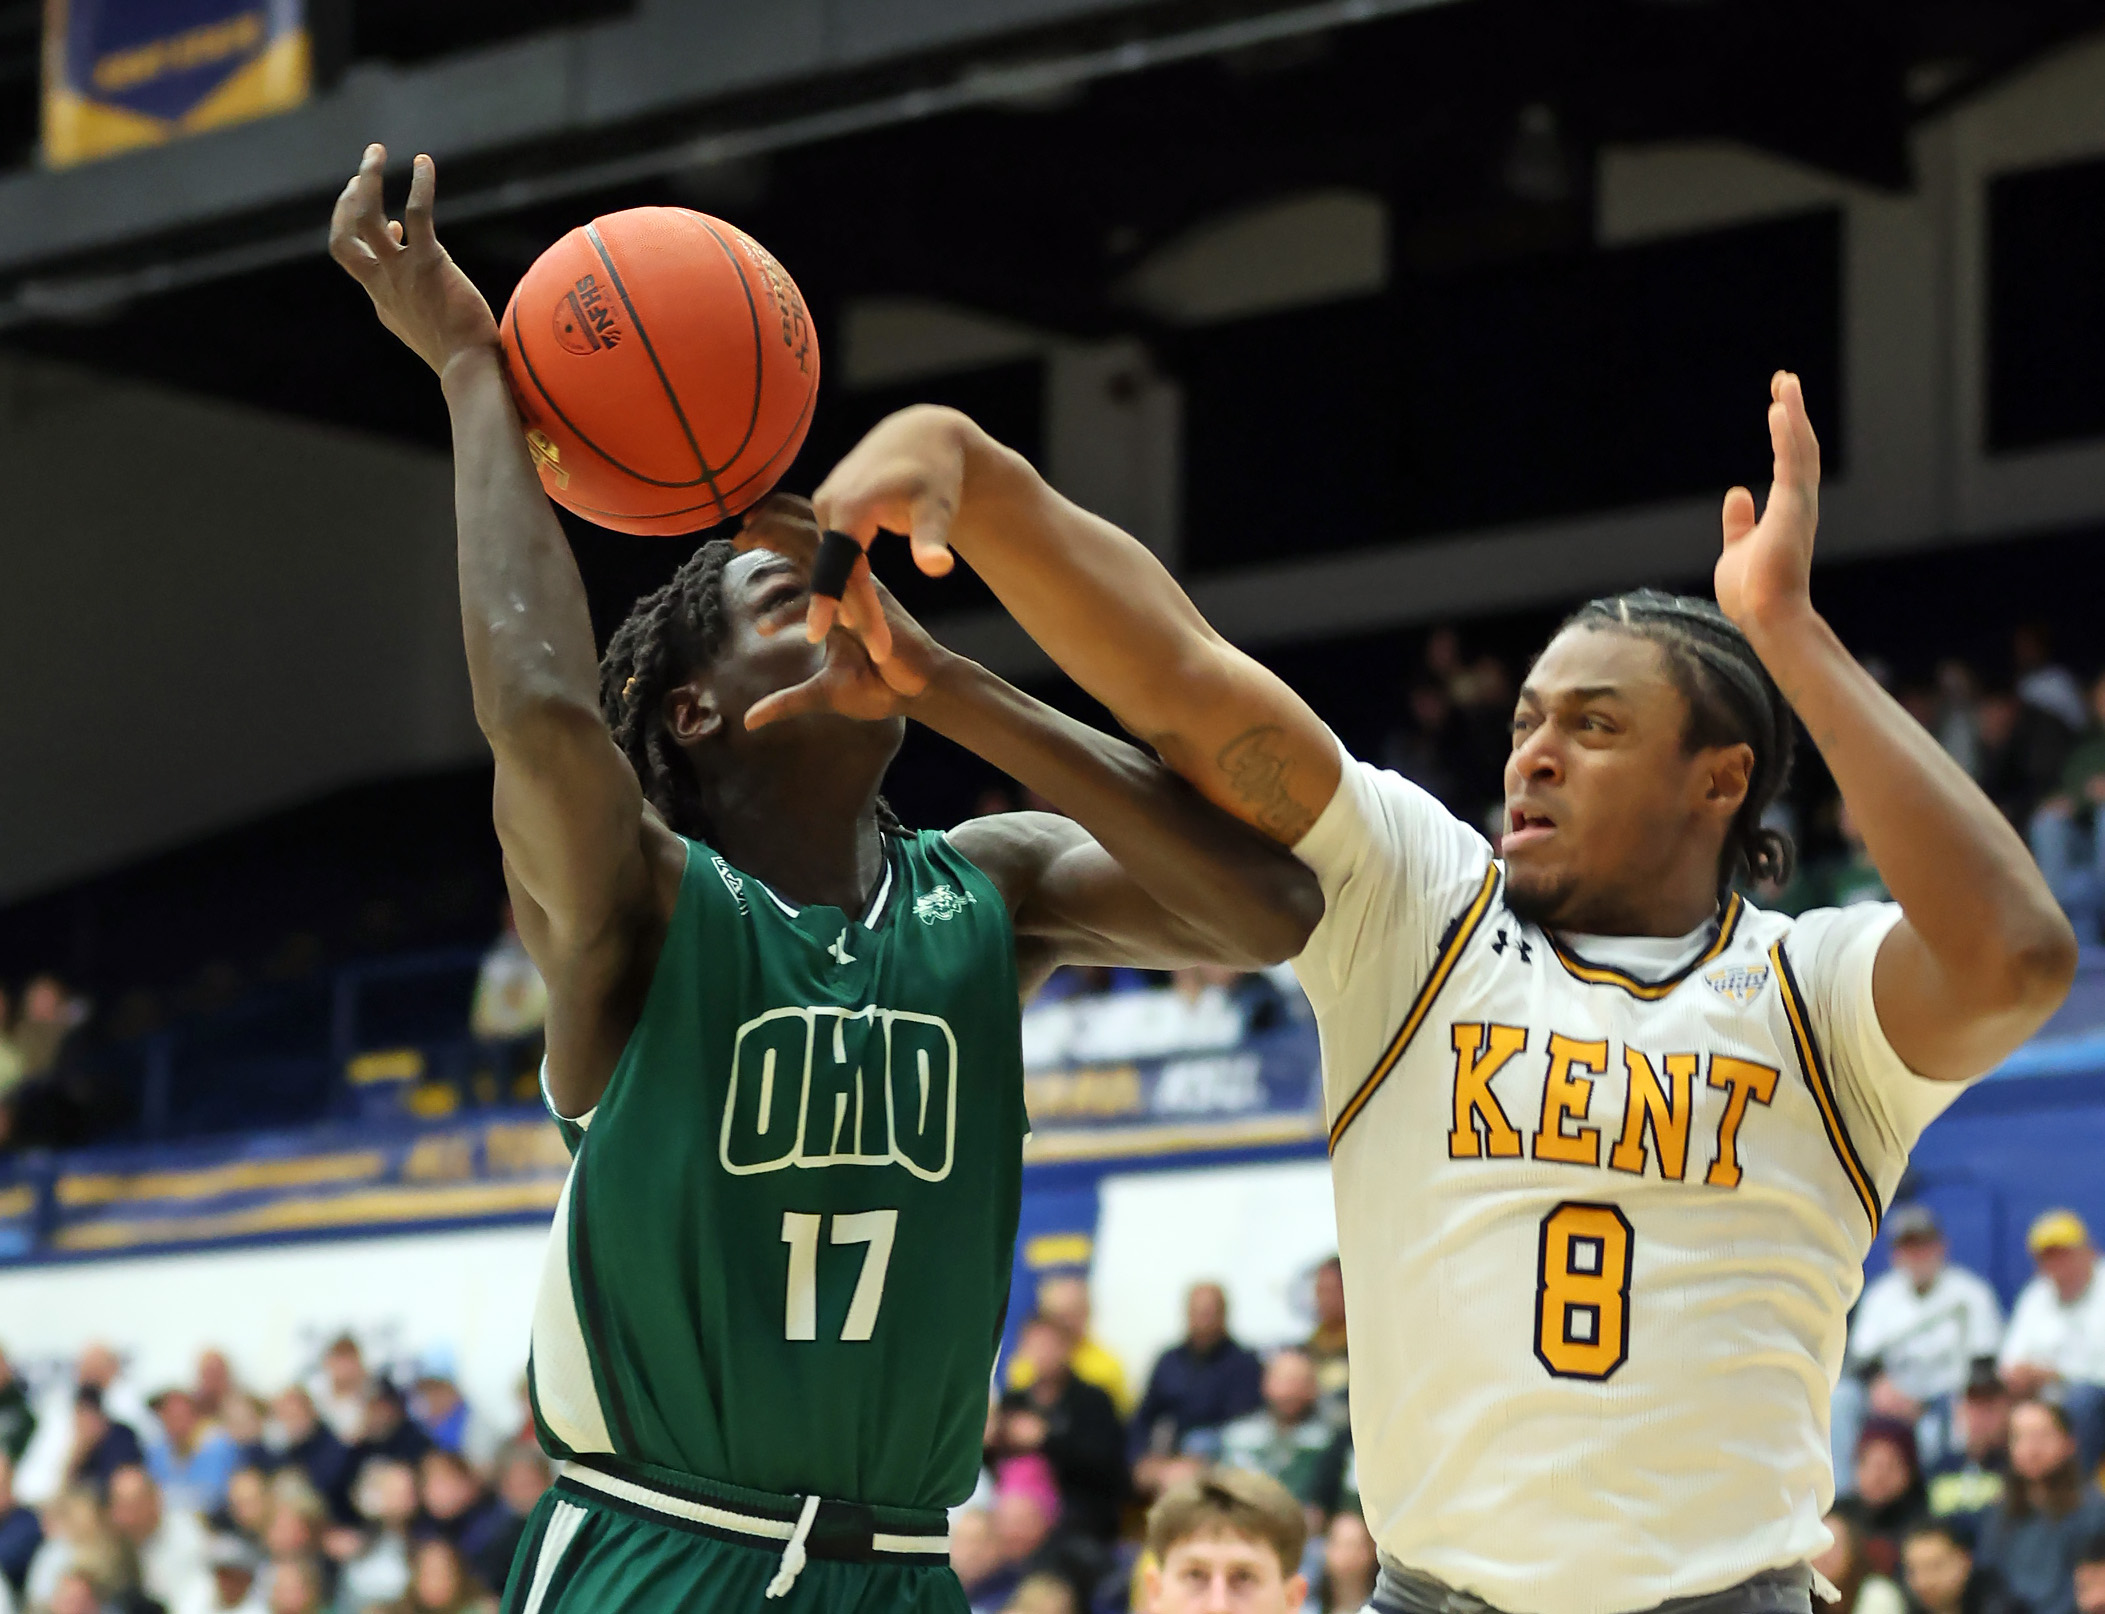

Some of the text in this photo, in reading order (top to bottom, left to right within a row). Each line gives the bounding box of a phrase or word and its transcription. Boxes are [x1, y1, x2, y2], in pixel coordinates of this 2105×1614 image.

[576, 274, 615, 332] NFHS
[719, 1005, 957, 1183] OHIO
[1448, 1022, 1780, 1188] KENT
[781, 1209, 898, 1341] 17
[1534, 1201, 1635, 1379] 8
